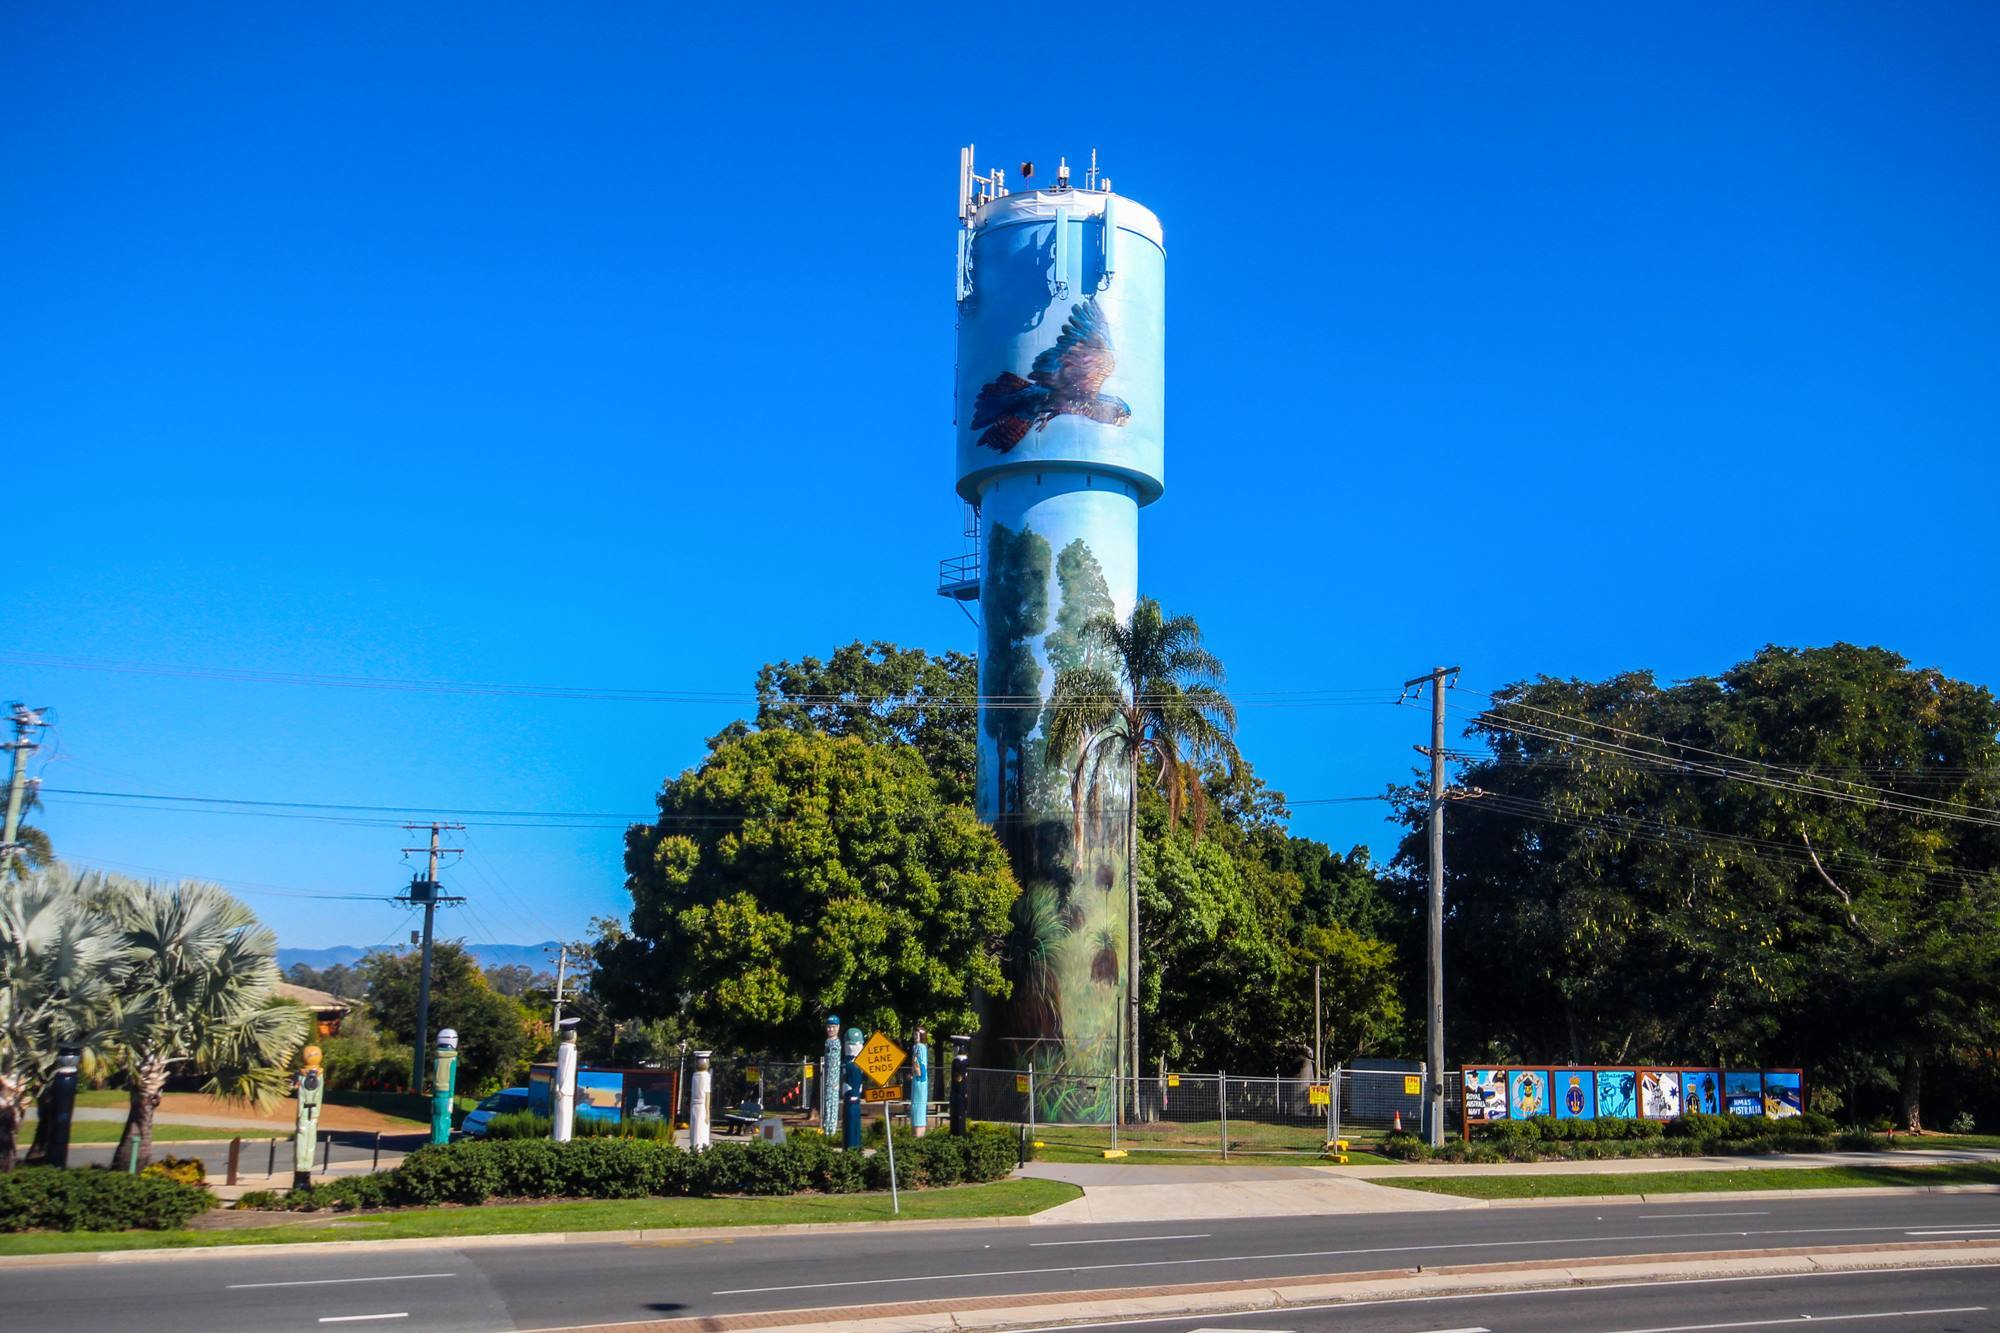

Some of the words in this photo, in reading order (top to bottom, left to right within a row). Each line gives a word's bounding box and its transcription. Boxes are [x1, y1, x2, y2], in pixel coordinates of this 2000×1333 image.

[868, 1045, 890, 1055] LEFT
[868, 1055, 892, 1064] LANE
[869, 1064, 893, 1073] ENDS
[1466, 1092, 1481, 1100] ROYAL
[1468, 1107, 1481, 1115] NAVY
[1729, 1105, 1762, 1115] AUSTRALIA
